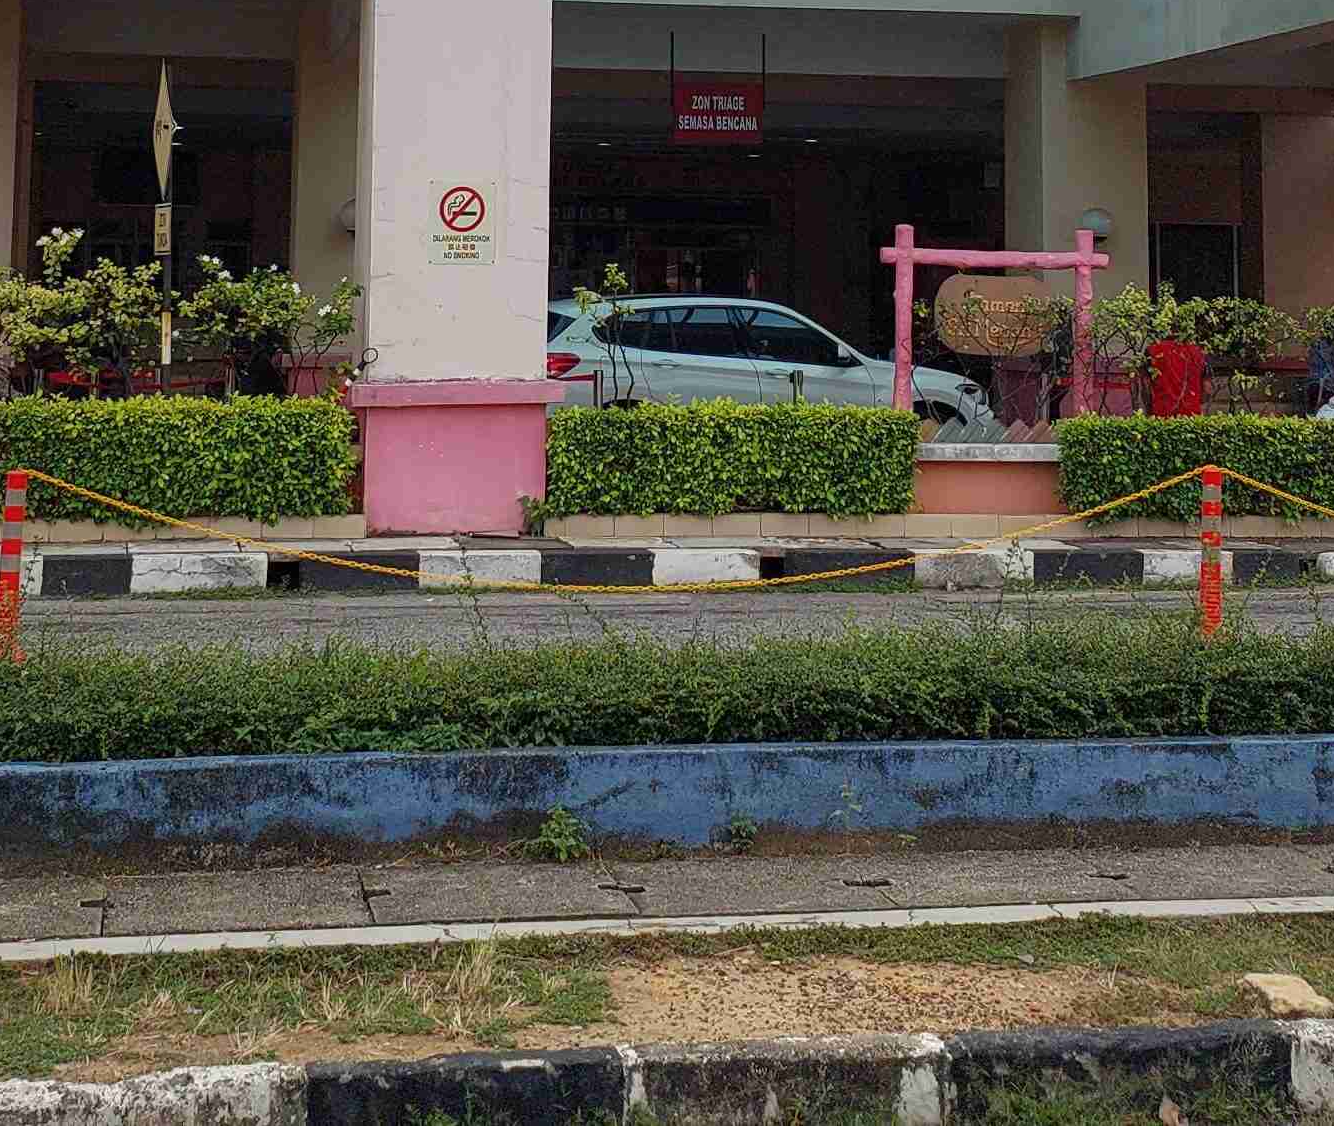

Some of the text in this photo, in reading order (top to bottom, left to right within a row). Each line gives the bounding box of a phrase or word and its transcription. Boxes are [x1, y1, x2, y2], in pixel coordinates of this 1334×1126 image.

[691, 95, 745, 111] ZON TRIAGE
[678, 114, 758, 131] SEMASA BENCANA
